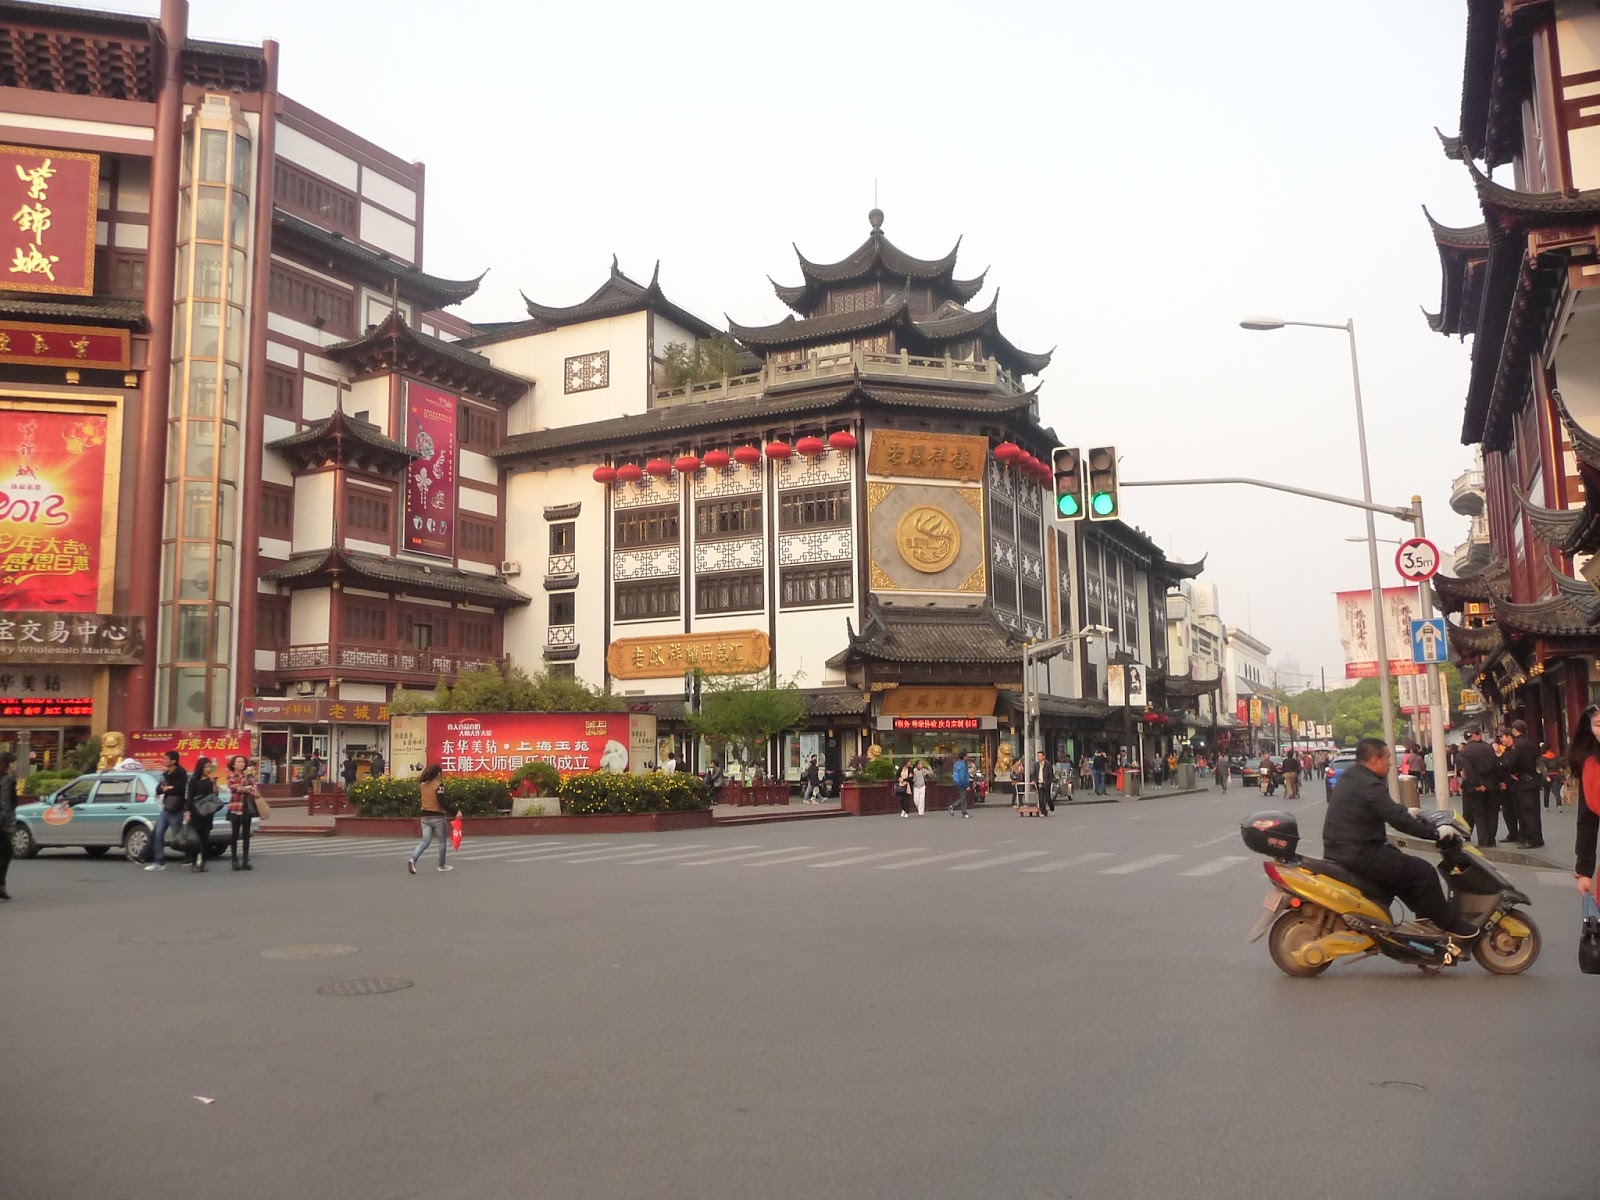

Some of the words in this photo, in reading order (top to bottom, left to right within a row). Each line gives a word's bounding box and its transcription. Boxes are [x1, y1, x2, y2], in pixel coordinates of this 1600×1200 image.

[1, 553, 90, 572] 感恩巨惠
[1403, 552, 1433, 569] 3.5m
[0, 618, 128, 644] 宝交易中心
[17, 645, 79, 654] Wholesale
[82, 646, 122, 655] Market
[175, 738, 239, 750] 开张大送礼
[442, 740, 497, 754] 东华美钻
